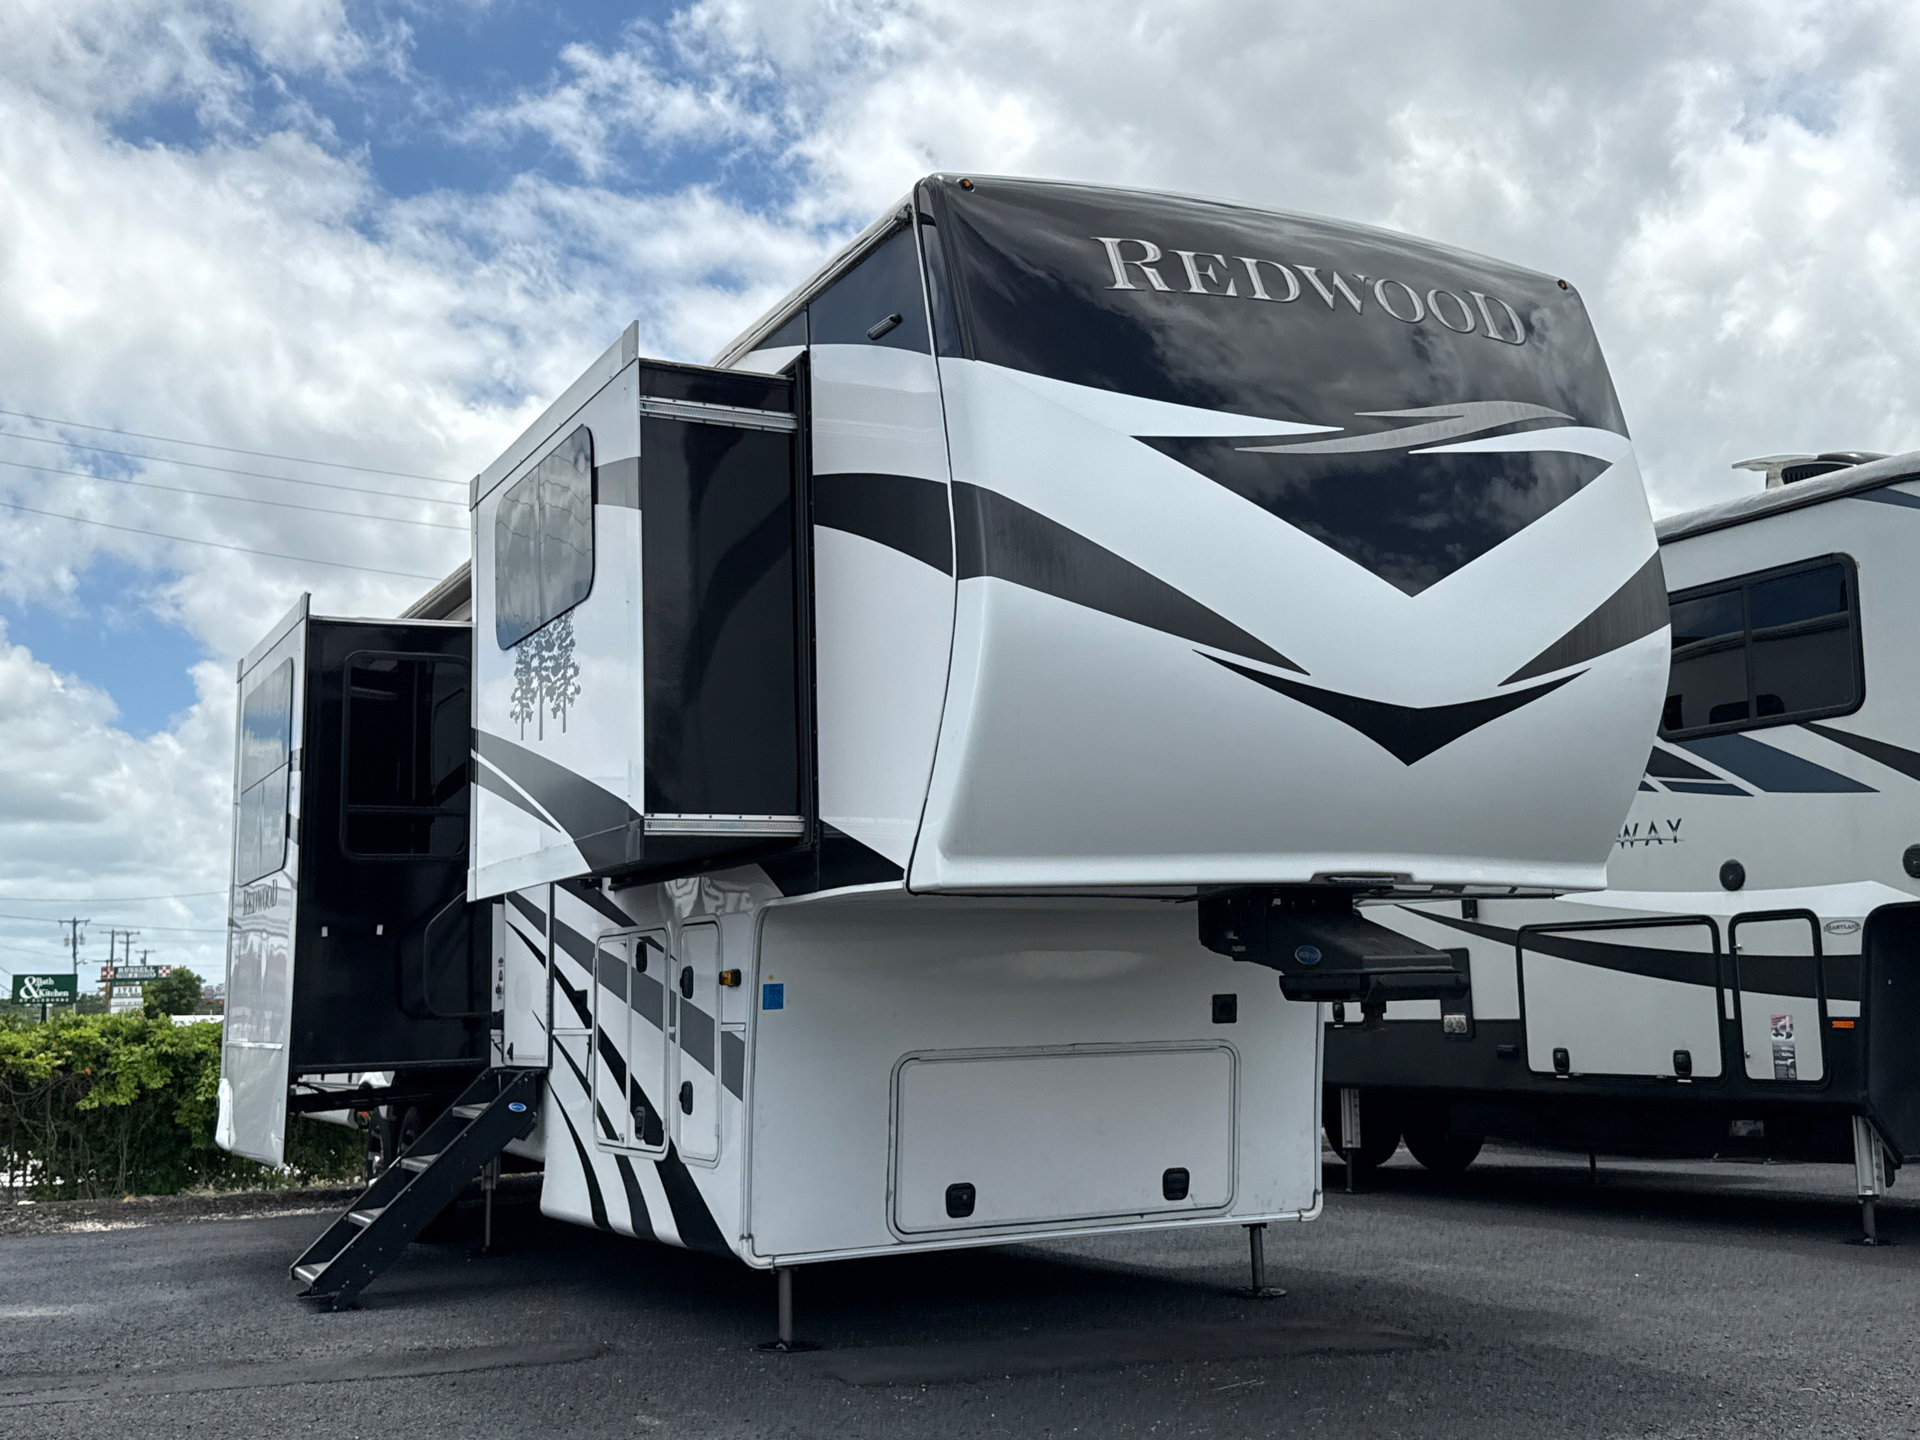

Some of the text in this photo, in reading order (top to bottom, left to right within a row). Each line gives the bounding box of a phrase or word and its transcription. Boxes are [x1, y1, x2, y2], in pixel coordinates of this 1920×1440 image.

[1090, 236, 1527, 346] REDWOOD
[243, 879, 278, 916] REDWOOD
[19, 976, 40, 999] &
[39, 988, 69, 997] Kitchen
